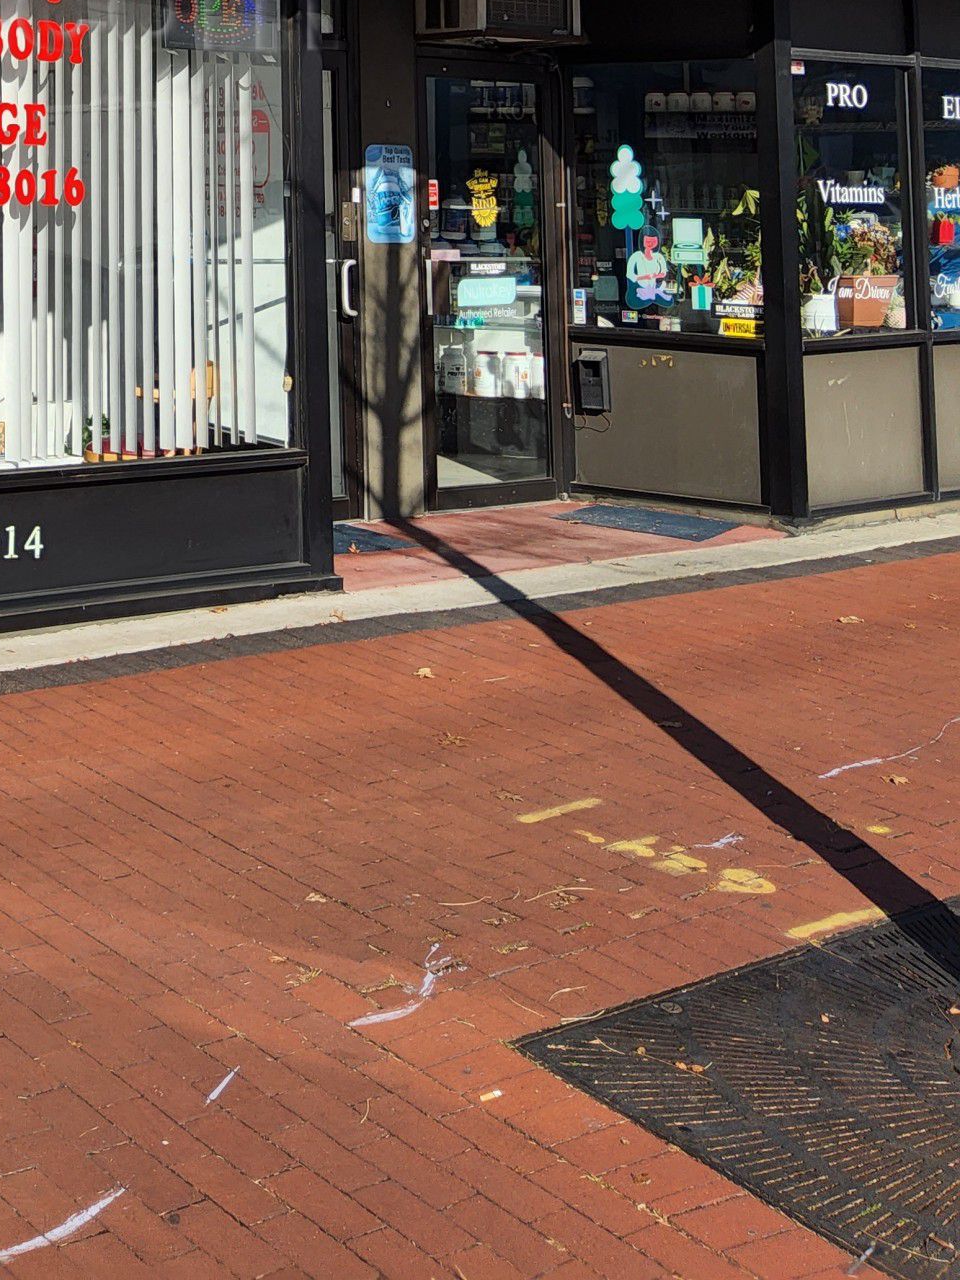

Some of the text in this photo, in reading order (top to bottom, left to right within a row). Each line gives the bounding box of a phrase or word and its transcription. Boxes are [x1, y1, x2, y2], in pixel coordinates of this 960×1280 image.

[826, 82, 868, 109] PRO
[382, 155, 395, 163] Best
[817, 178, 886, 205] Vitamins
[854, 277, 892, 300] Driven
